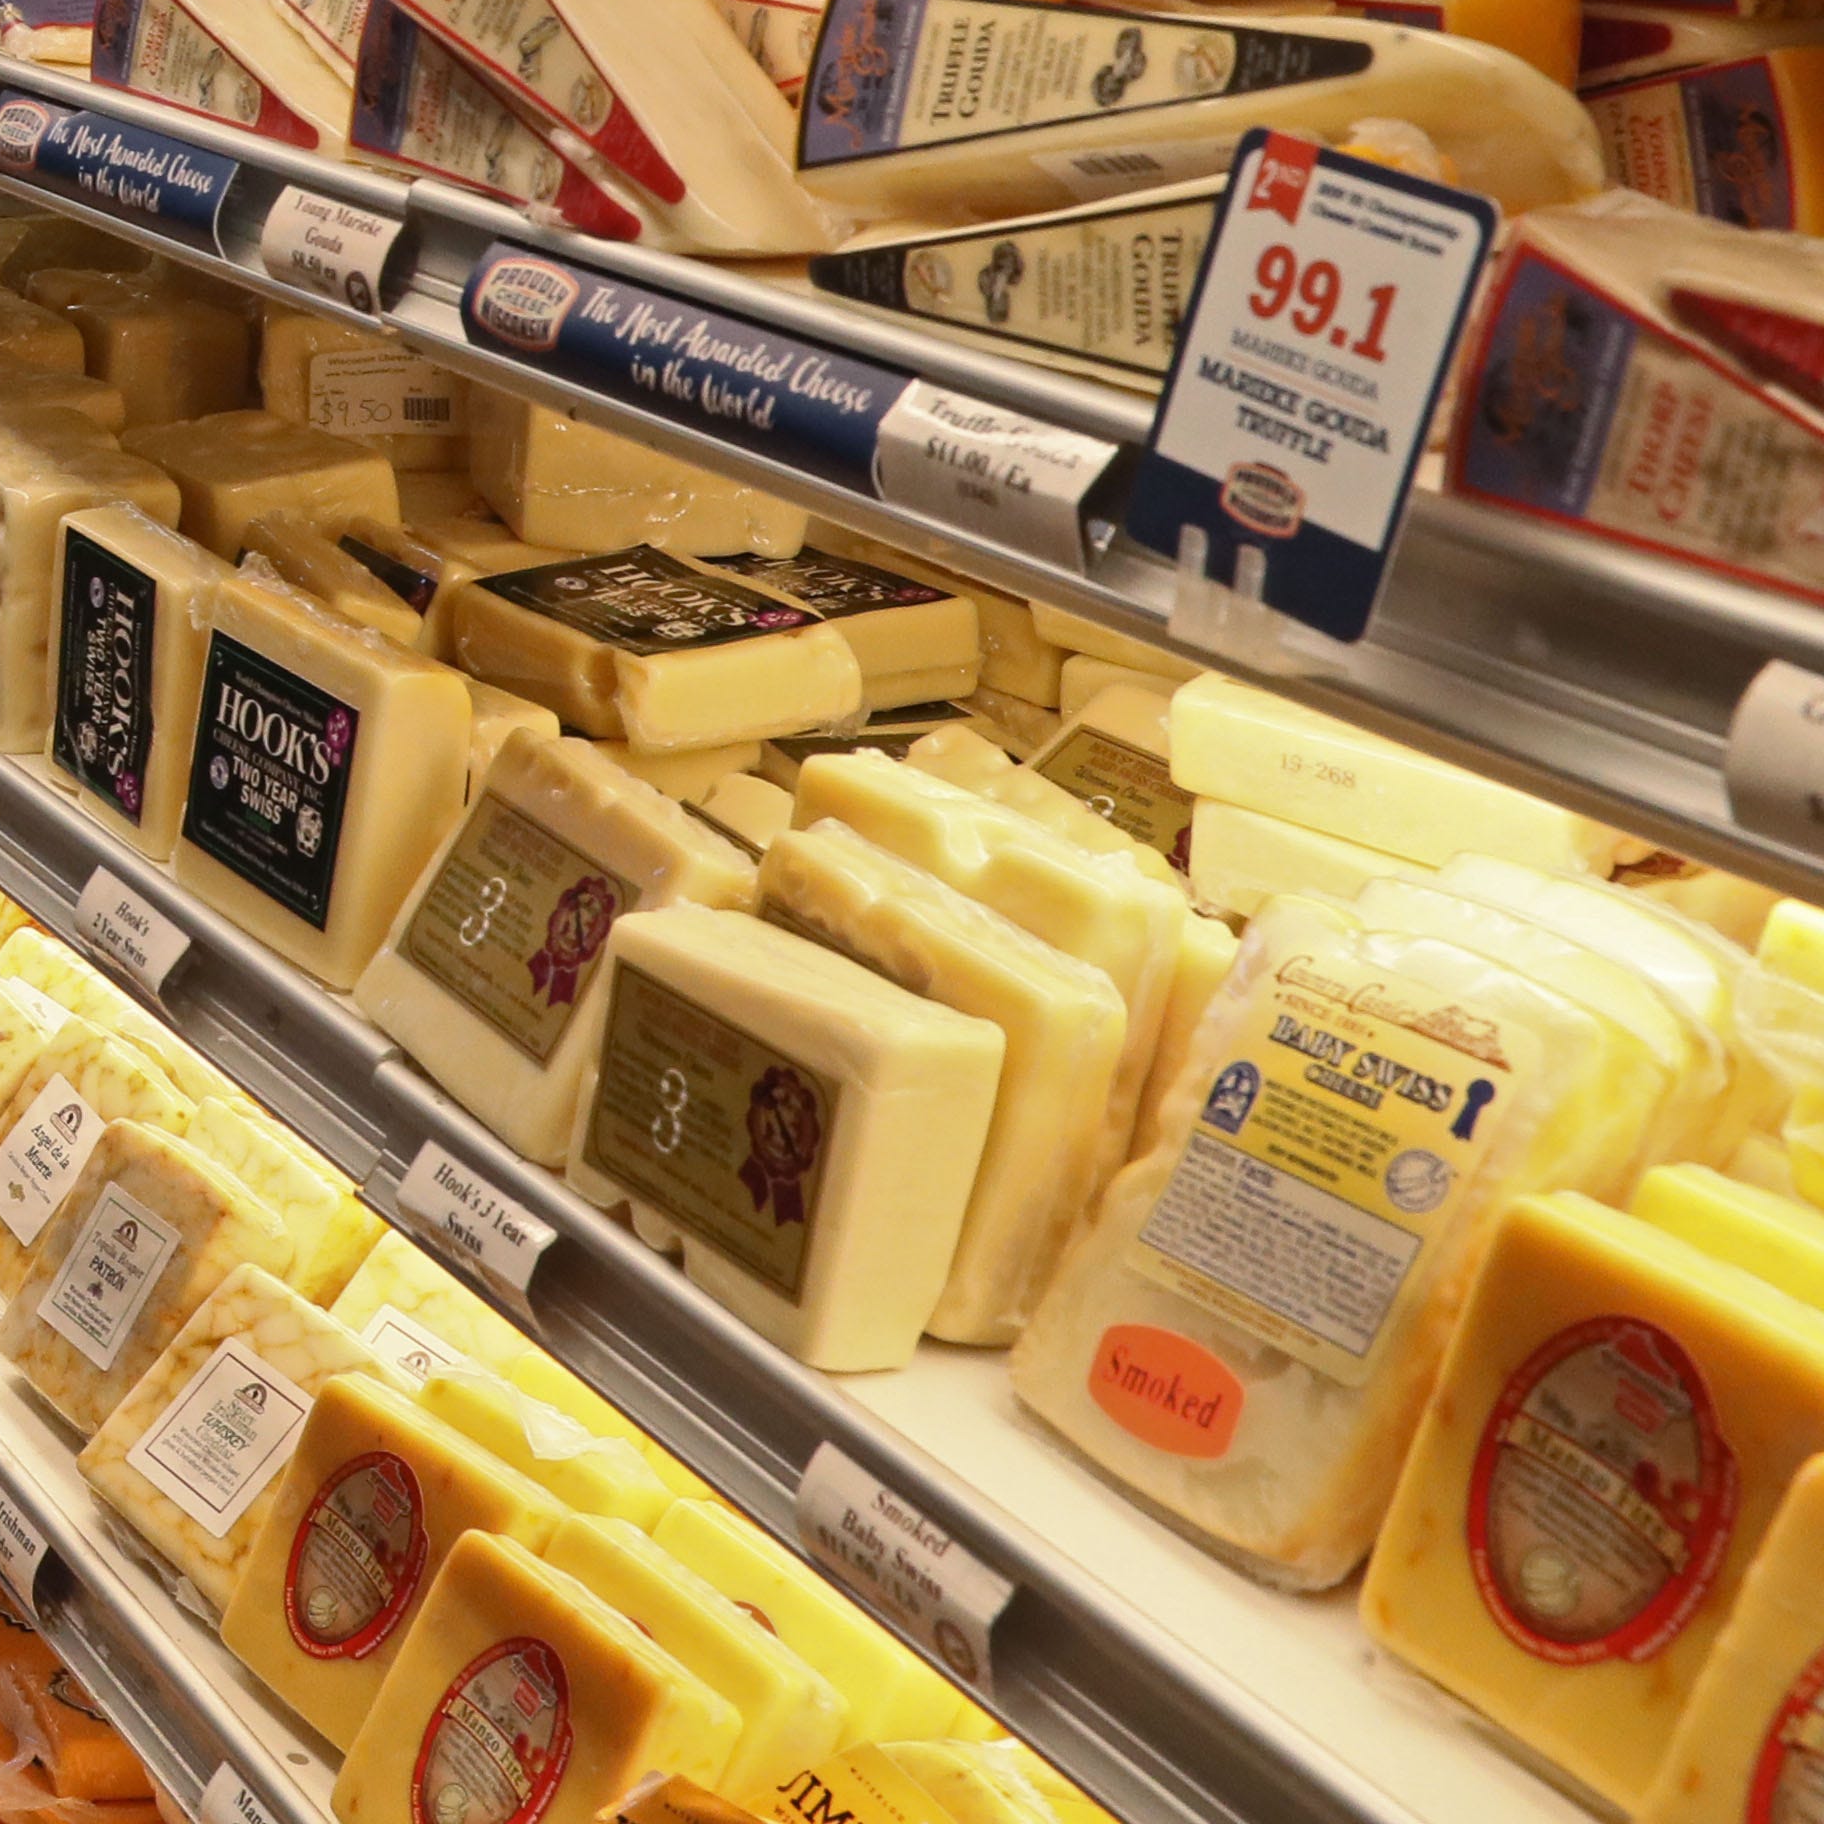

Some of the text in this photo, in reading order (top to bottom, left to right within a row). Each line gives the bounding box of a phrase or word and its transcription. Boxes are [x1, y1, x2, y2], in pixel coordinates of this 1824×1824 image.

[930, 16, 971, 126] TRUFFLE
[957, 19, 997, 118] GOUDA
[48, 117, 214, 195] The Most Awarded Cheese
[78, 166, 161, 213] in the World
[291, 195, 383, 237] Young Marieke
[304, 226, 343, 255] Gouda
[493, 287, 551, 317] CHEESE
[495, 265, 572, 309] PROUDLY
[1133, 232, 1153, 346] GOUDA
[1247, 243, 1399, 364] 99.1
[482, 298, 555, 344] WISCONSIN
[578, 285, 874, 414] The Most Awarded Cheese
[631, 353, 777, 431] in the World
[1198, 355, 1391, 456] MARIEKE GOUDA
[1233, 406, 1335, 464] TRUFFLE
[599, 562, 750, 627] HOOK'S
[106, 587, 136, 780] HOOK'S
[215, 681, 333, 786] HOOK'S
[231, 753, 300, 814] TWO YEAR
[239, 784, 283, 826] SWISS
[100, 916, 149, 970] Year Swiss
[115, 899, 152, 937] Hook's
[1267, 1014, 1455, 1113] BABY SWISS
[1303, 1063, 1385, 1111] CHEESE
[31, 1123, 54, 1150] Angel
[59, 1155, 71, 1171] la
[433, 1160, 529, 1249] Hook's 3 Year
[442, 1210, 485, 1257] Swiss
[1101, 1344, 1226, 1432] Smoked
[199, 1411, 252, 1452] WHISKEY
[324, 1512, 387, 1588] Mango Fire
[840, 1506, 887, 1560] Baby
[893, 1550, 944, 1601] Swiss
[870, 1491, 954, 1558] Smoked
[456, 1702, 526, 1786] Mango Fire
